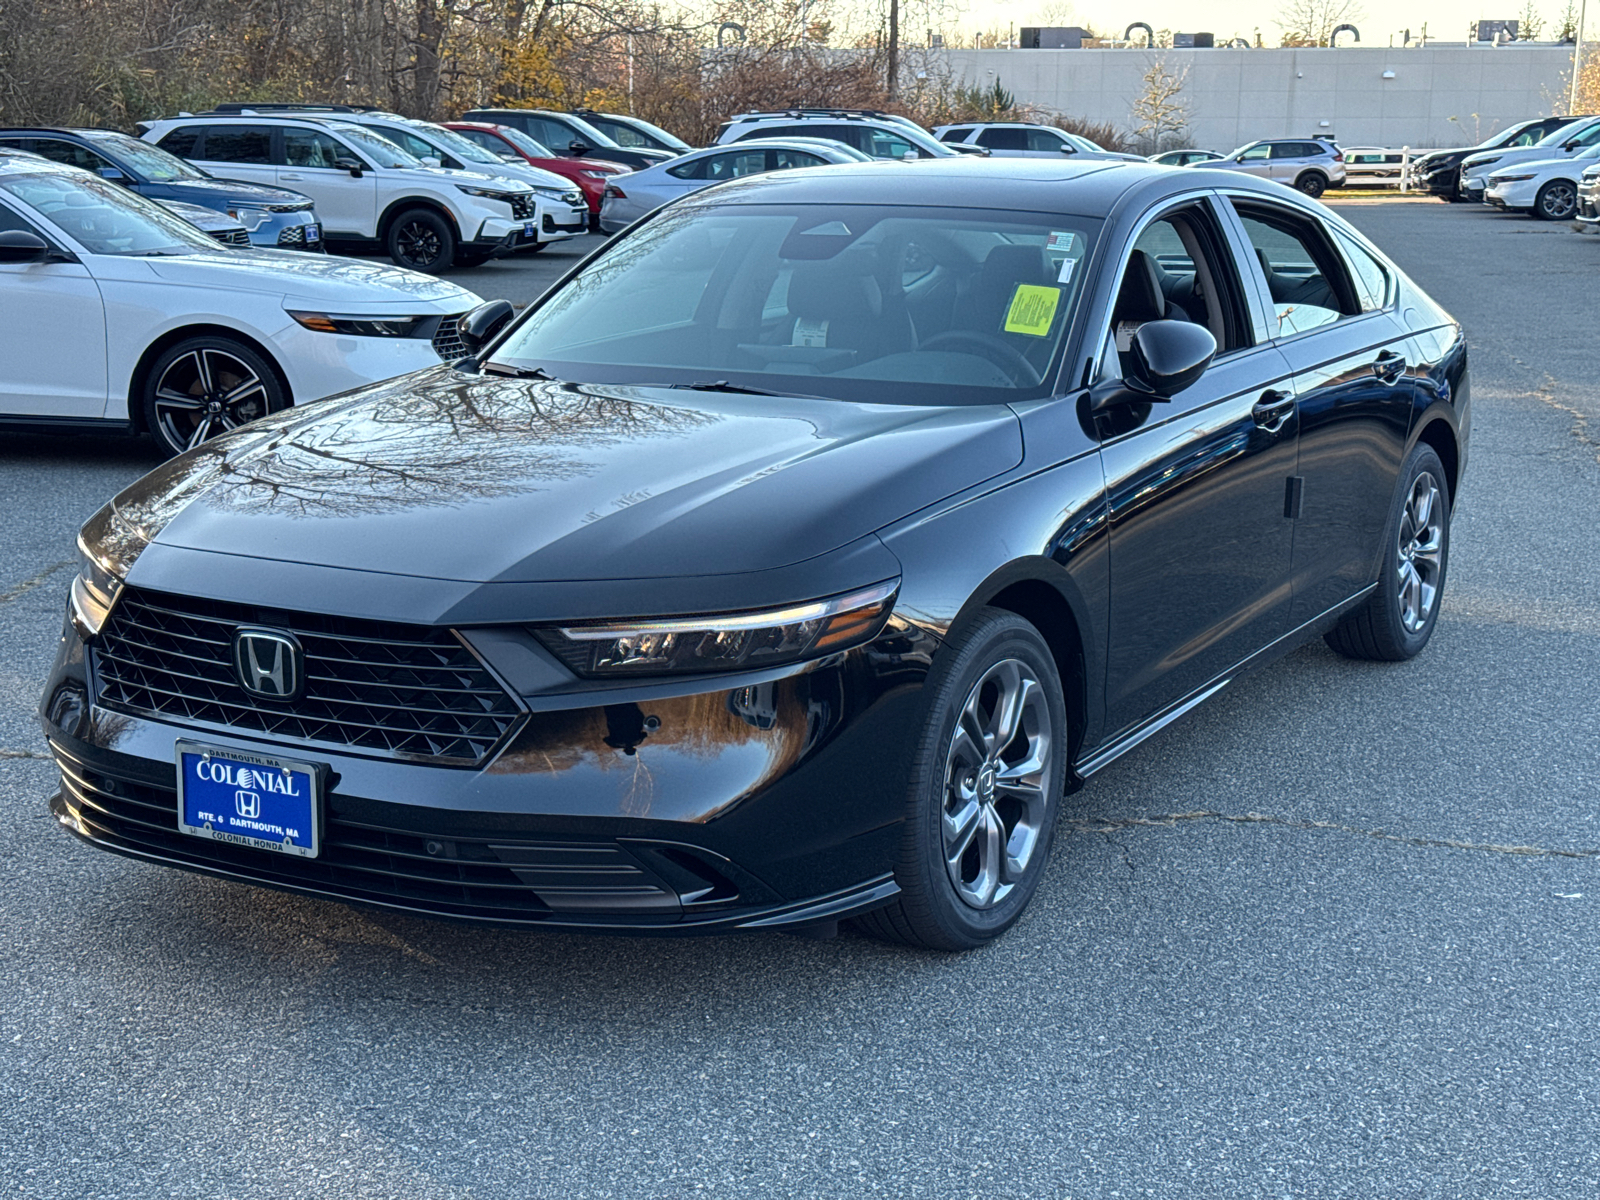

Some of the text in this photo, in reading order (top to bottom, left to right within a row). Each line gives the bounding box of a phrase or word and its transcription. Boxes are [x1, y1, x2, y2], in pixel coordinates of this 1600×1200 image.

[266, 758, 281, 767] MA
[196, 760, 300, 797] COLONIAL
[198, 811, 299, 838] RTE. 6 DARTMOUTH, MA
[212, 831, 284, 852] COLONIAL HONDA
